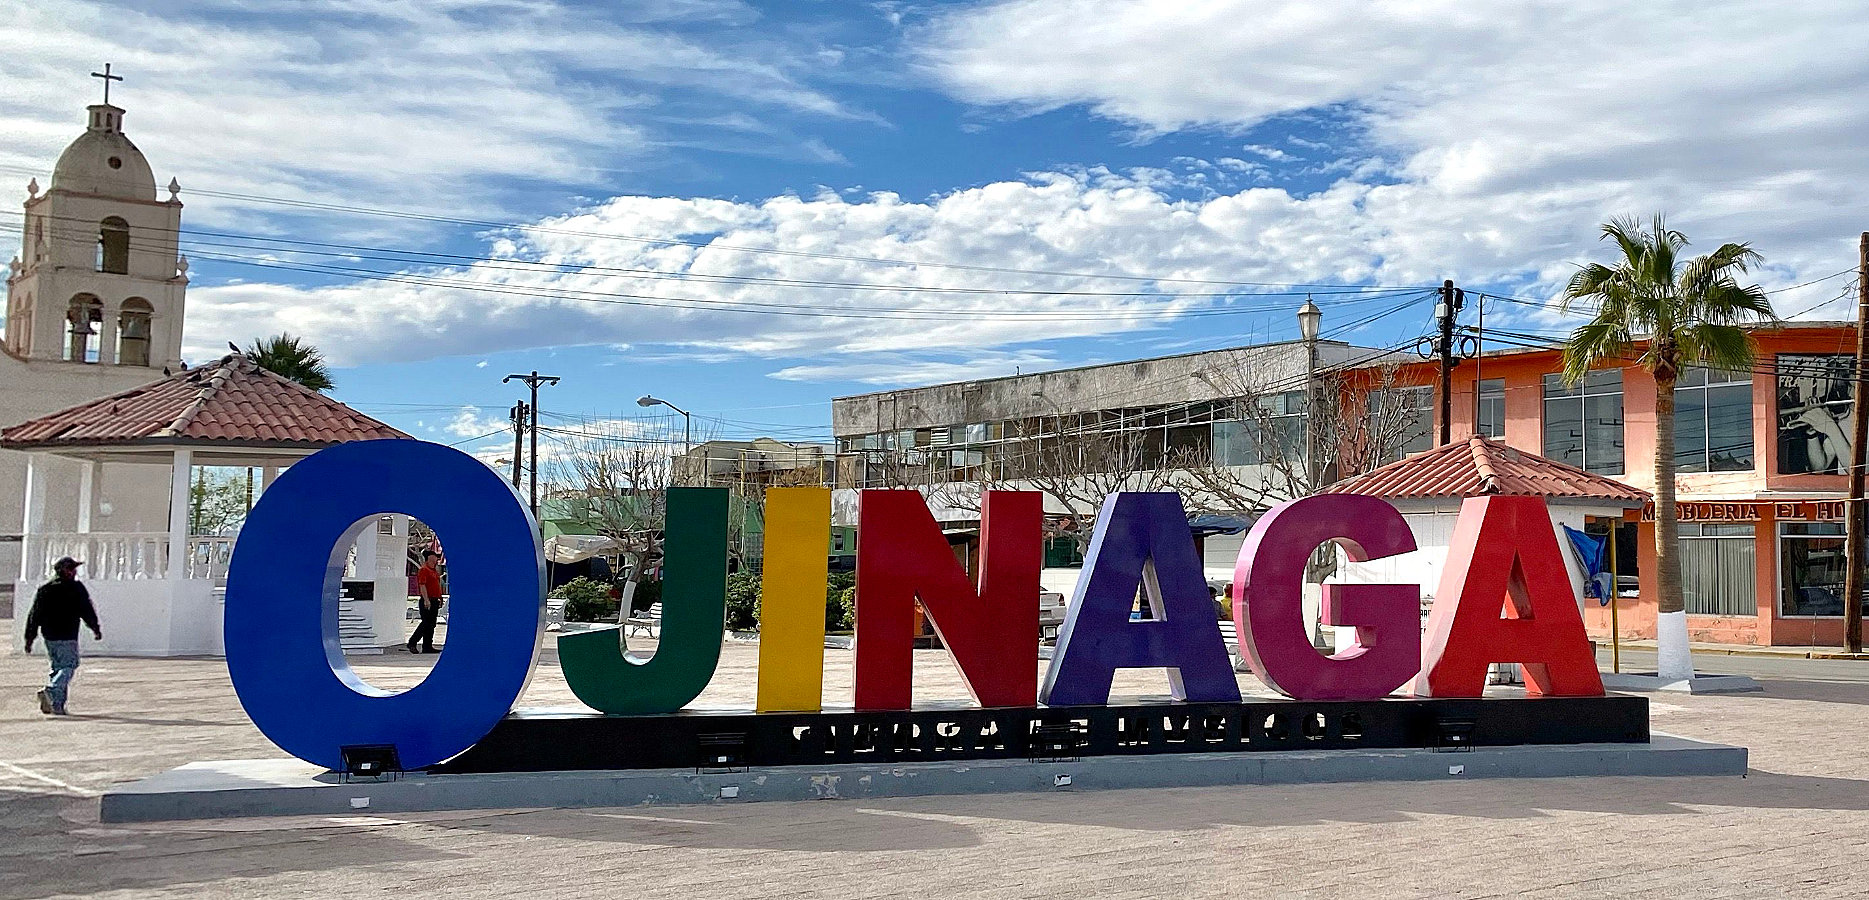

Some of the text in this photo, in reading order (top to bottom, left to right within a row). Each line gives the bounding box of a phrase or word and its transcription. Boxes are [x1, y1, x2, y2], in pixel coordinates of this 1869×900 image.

[1641, 503, 1761, 522] MBLERIA
[1774, 503, 1806, 520] EL
[224, 440, 1605, 771] OJINAGA
